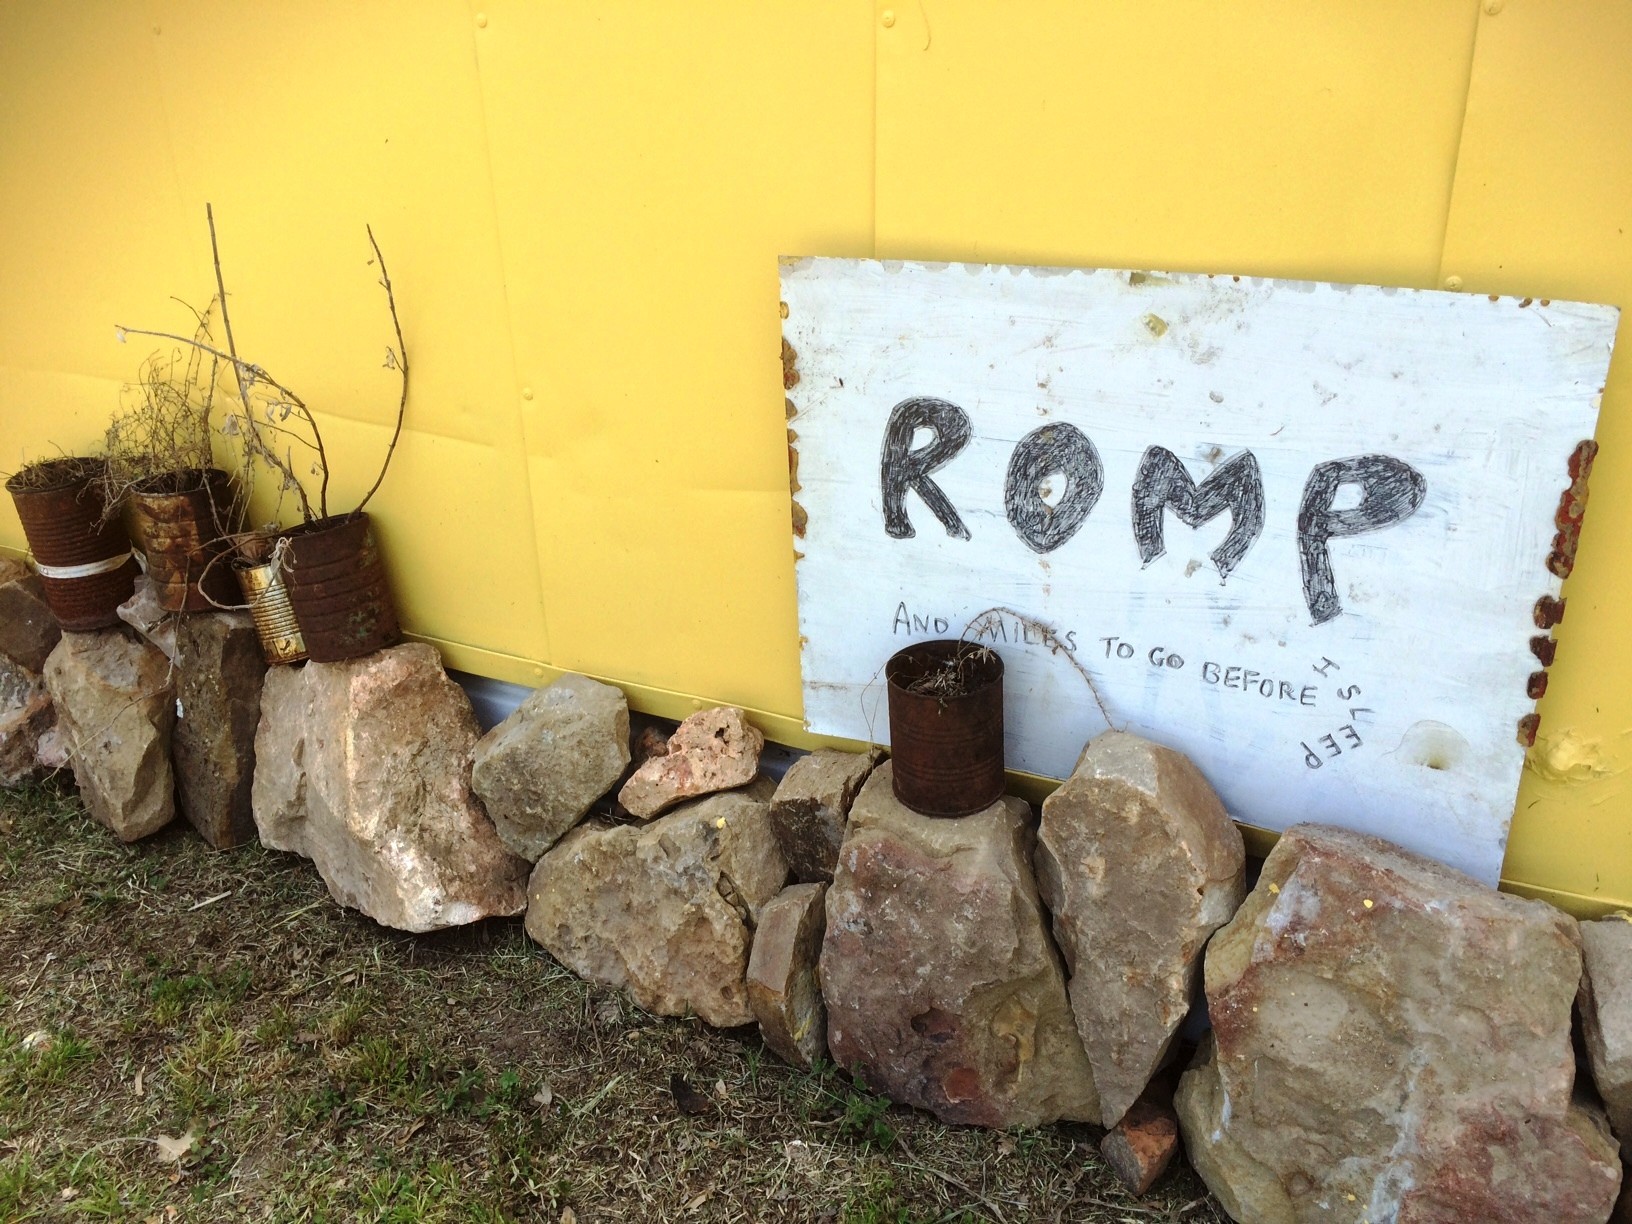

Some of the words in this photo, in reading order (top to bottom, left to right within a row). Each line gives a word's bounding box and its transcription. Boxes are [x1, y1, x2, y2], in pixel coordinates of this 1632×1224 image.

[881, 397, 1427, 627] ROMP
[893, 601, 949, 635] AND
[1099, 636, 1134, 659] TO
[1149, 646, 1185, 669] GO
[1202, 661, 1317, 707] BEFORE
[1300, 684, 1376, 769] SLEEP
